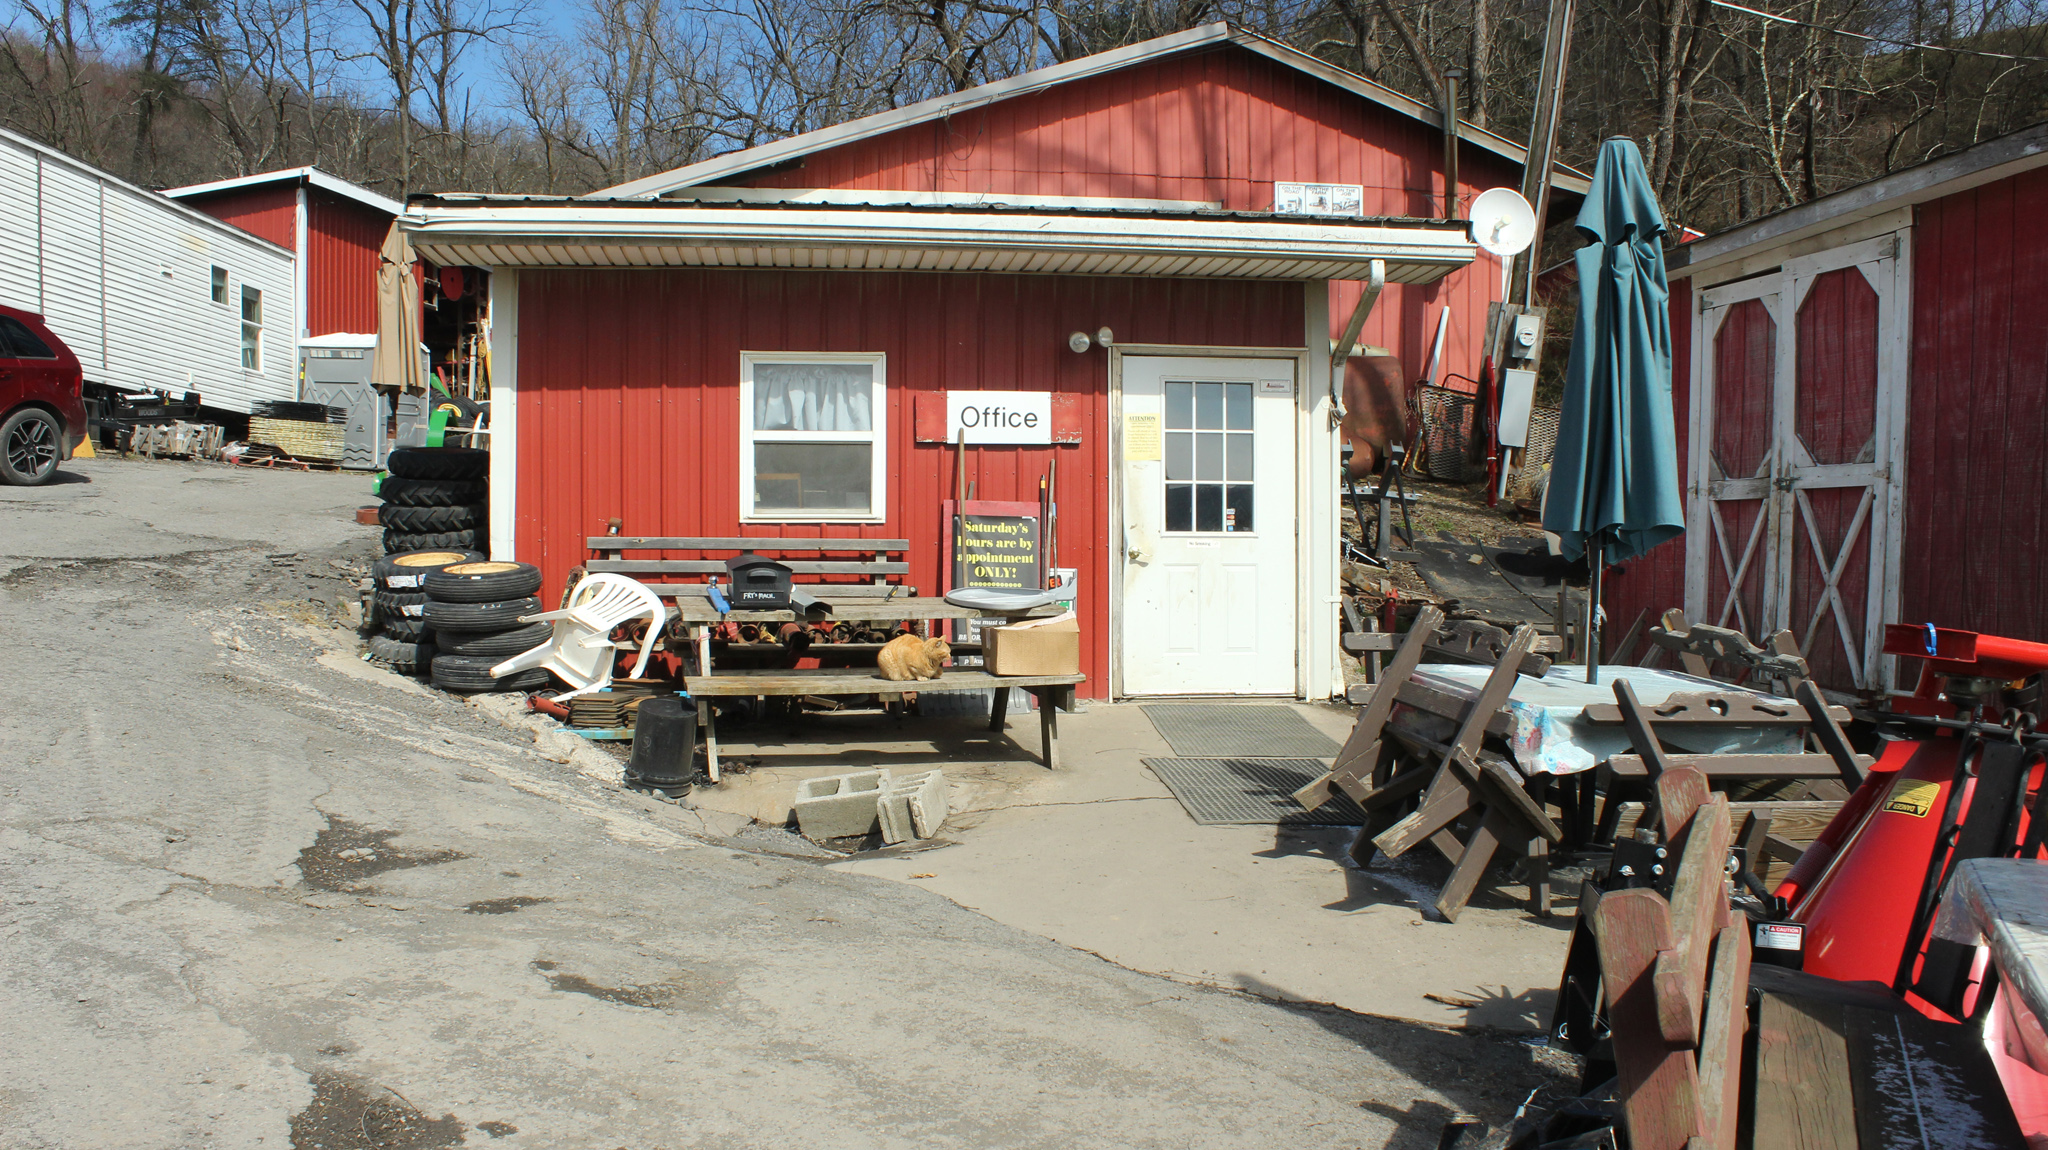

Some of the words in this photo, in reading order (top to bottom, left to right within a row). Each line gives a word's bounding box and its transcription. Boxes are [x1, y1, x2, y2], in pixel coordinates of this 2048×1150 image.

[961, 405, 1038, 428] Office
[964, 521, 1029, 536] Saturday's
[995, 540, 1017, 548] are
[1019, 537, 1034, 551] by
[957, 552, 1034, 565] appointment
[974, 565, 1017, 578] ONLY!
[1892, 803, 1917, 812] DANGER
[1775, 926, 1799, 934] CAUTION
